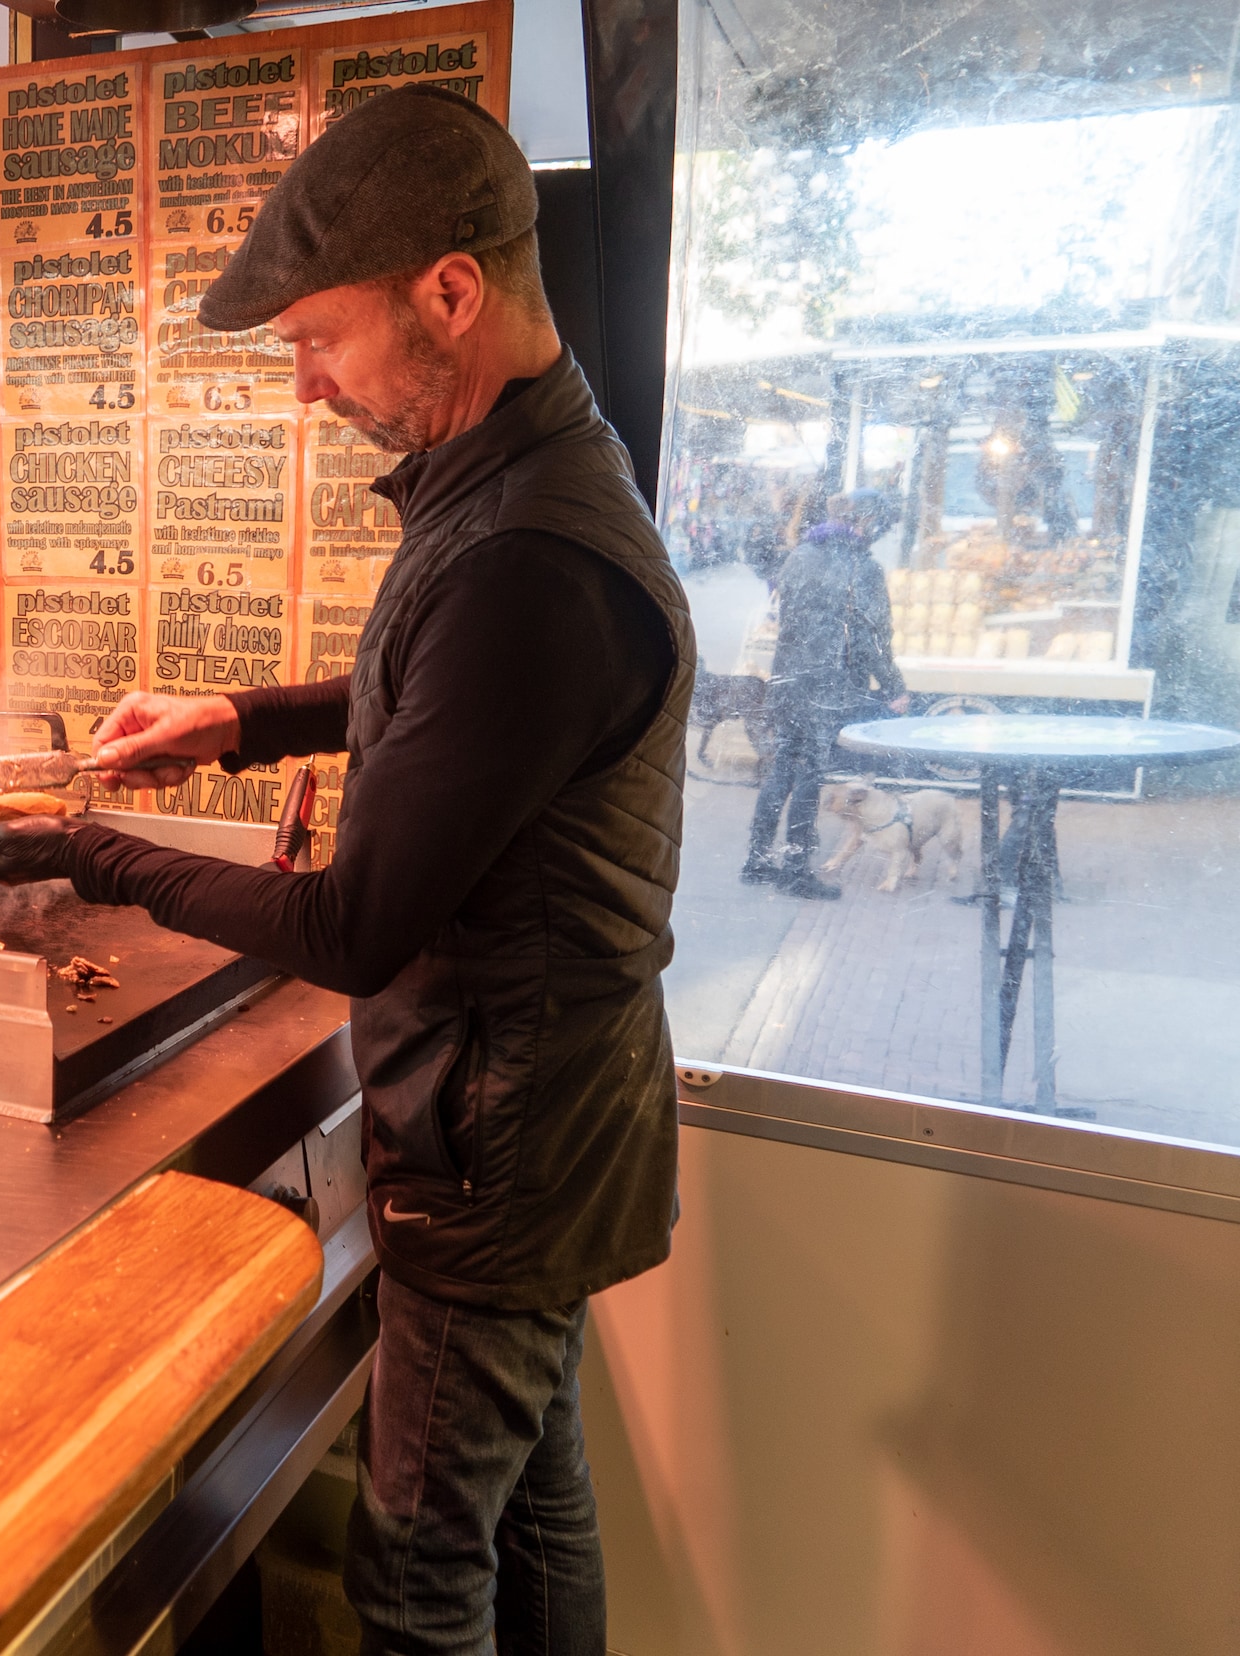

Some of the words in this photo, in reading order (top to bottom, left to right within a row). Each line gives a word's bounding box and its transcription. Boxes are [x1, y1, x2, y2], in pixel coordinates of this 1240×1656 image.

[164, 54, 295, 100] pistolet
[333, 39, 477, 87] pistolet
[8, 72, 129, 116] pistolet
[325, 84, 392, 119] BO
[2, 112, 65, 151] HOME
[70, 104, 133, 144] MADE
[164, 90, 296, 134] BEEF
[3, 138, 136, 181] sausage
[0, 188, 22, 205] THE
[23, 185, 51, 203] BEST
[53, 184, 65, 201] IN
[66, 178, 134, 200] AMSTERDAM
[159, 174, 184, 193] with
[160, 193, 212, 208] mushrooms
[213, 190, 231, 205] and
[0, 204, 49, 220] MOSTERD
[50, 201, 79, 215] MAYO
[81, 197, 130, 213] KETCHUP
[206, 207, 256, 235] 6.5
[85, 210, 133, 239] 4.5
[13, 249, 132, 286] pistolet
[8, 281, 134, 319] CHORIPAN
[9, 312, 138, 353] sausage
[159, 354, 184, 368] with
[5, 373, 43, 388] topping
[44, 371, 66, 385] with
[156, 371, 171, 384] or
[88, 383, 136, 410] 4.5
[203, 385, 252, 411] 6.5
[15, 420, 131, 451] pistolet
[159, 423, 286, 454] pistolet
[9, 451, 131, 484] CHICKEN
[157, 454, 287, 489] CHEESY
[316, 446, 408, 478] molenaa
[10, 480, 137, 520] sausage
[156, 491, 284, 522] Pastrami
[6, 519, 25, 535] with
[25, 519, 64, 536] icelettuce
[153, 525, 178, 541] with
[180, 525, 237, 543] icelettuce
[237, 526, 281, 545] pickles
[312, 526, 376, 542] mozzarella
[7, 536, 47, 551] topping
[49, 536, 72, 549] with
[73, 537, 130, 551] spicymayo
[151, 542, 173, 556] and
[253, 546, 284, 561] mayo
[309, 545, 326, 557] en
[89, 550, 135, 575] 4.5
[196, 561, 245, 588] 6.5
[17, 589, 131, 616] pistolet
[159, 587, 283, 618] pistolet
[12, 617, 137, 653] ESCOBAR
[156, 612, 211, 656] philly
[213, 616, 282, 655] cheese
[310, 631, 362, 662] pow
[12, 650, 137, 688] sausage
[155, 652, 282, 688] STEAK
[7, 682, 26, 697] with
[65, 685, 100, 703] jalapeno
[49, 700, 72, 713] with
[179, 686, 219, 697] icelett
[155, 772, 282, 824] CALZONE
